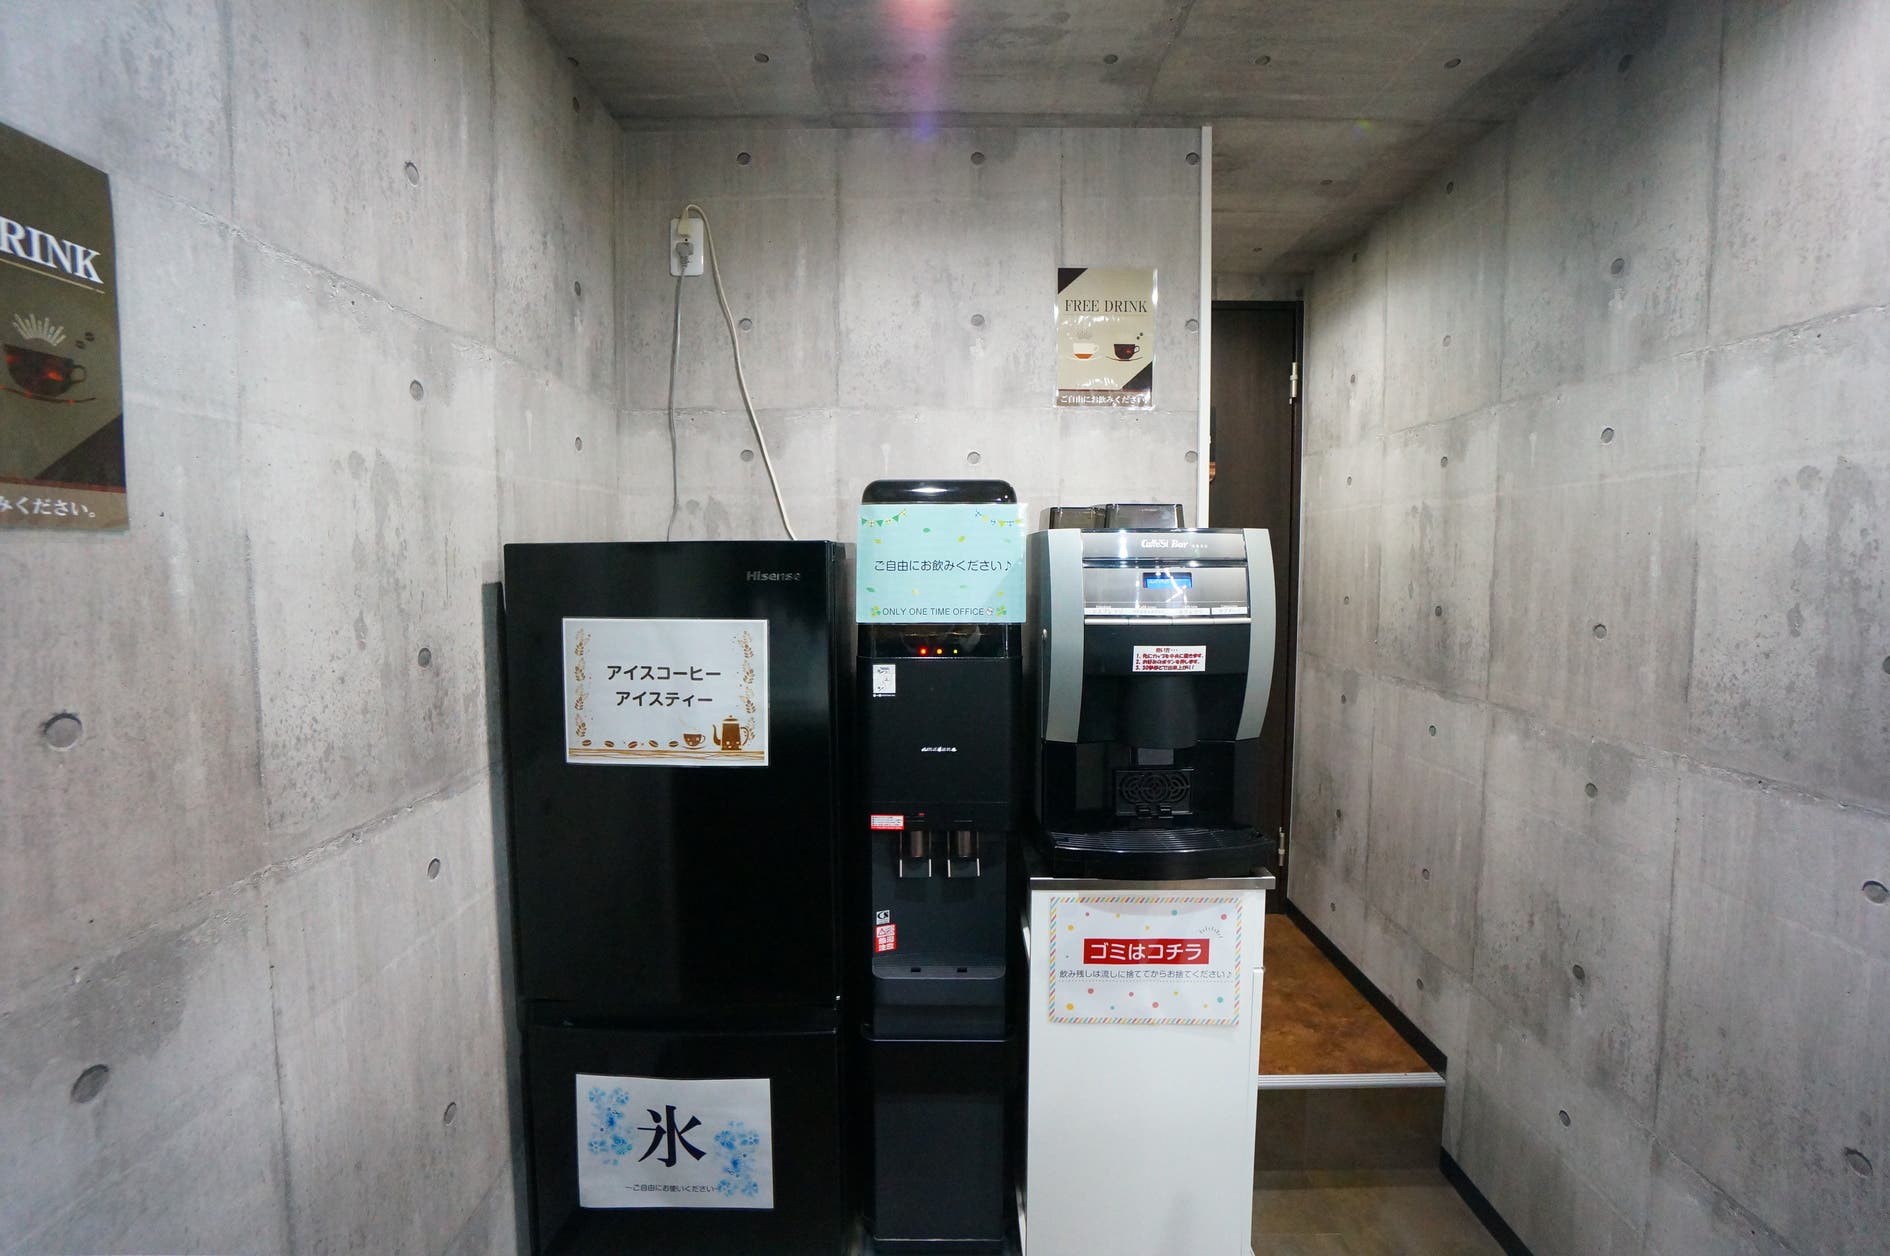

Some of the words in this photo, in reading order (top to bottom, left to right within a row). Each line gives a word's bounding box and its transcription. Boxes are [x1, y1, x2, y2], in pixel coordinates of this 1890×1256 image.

[1065, 299, 1099, 313] FREE
[1105, 299, 1147, 313] DRINK
[746, 570, 801, 581] Hisense
[882, 607, 906, 616] ONLY
[909, 607, 928, 616] ONE
[930, 607, 950, 616] TIME
[952, 607, 984, 616] OFFICE
[607, 665, 721, 681] アイスコーヒー
[615, 691, 713, 707] アイスティー
[1090, 942, 1202, 961] ゴミはコチラ
[637, 1104, 707, 1168] 氷
